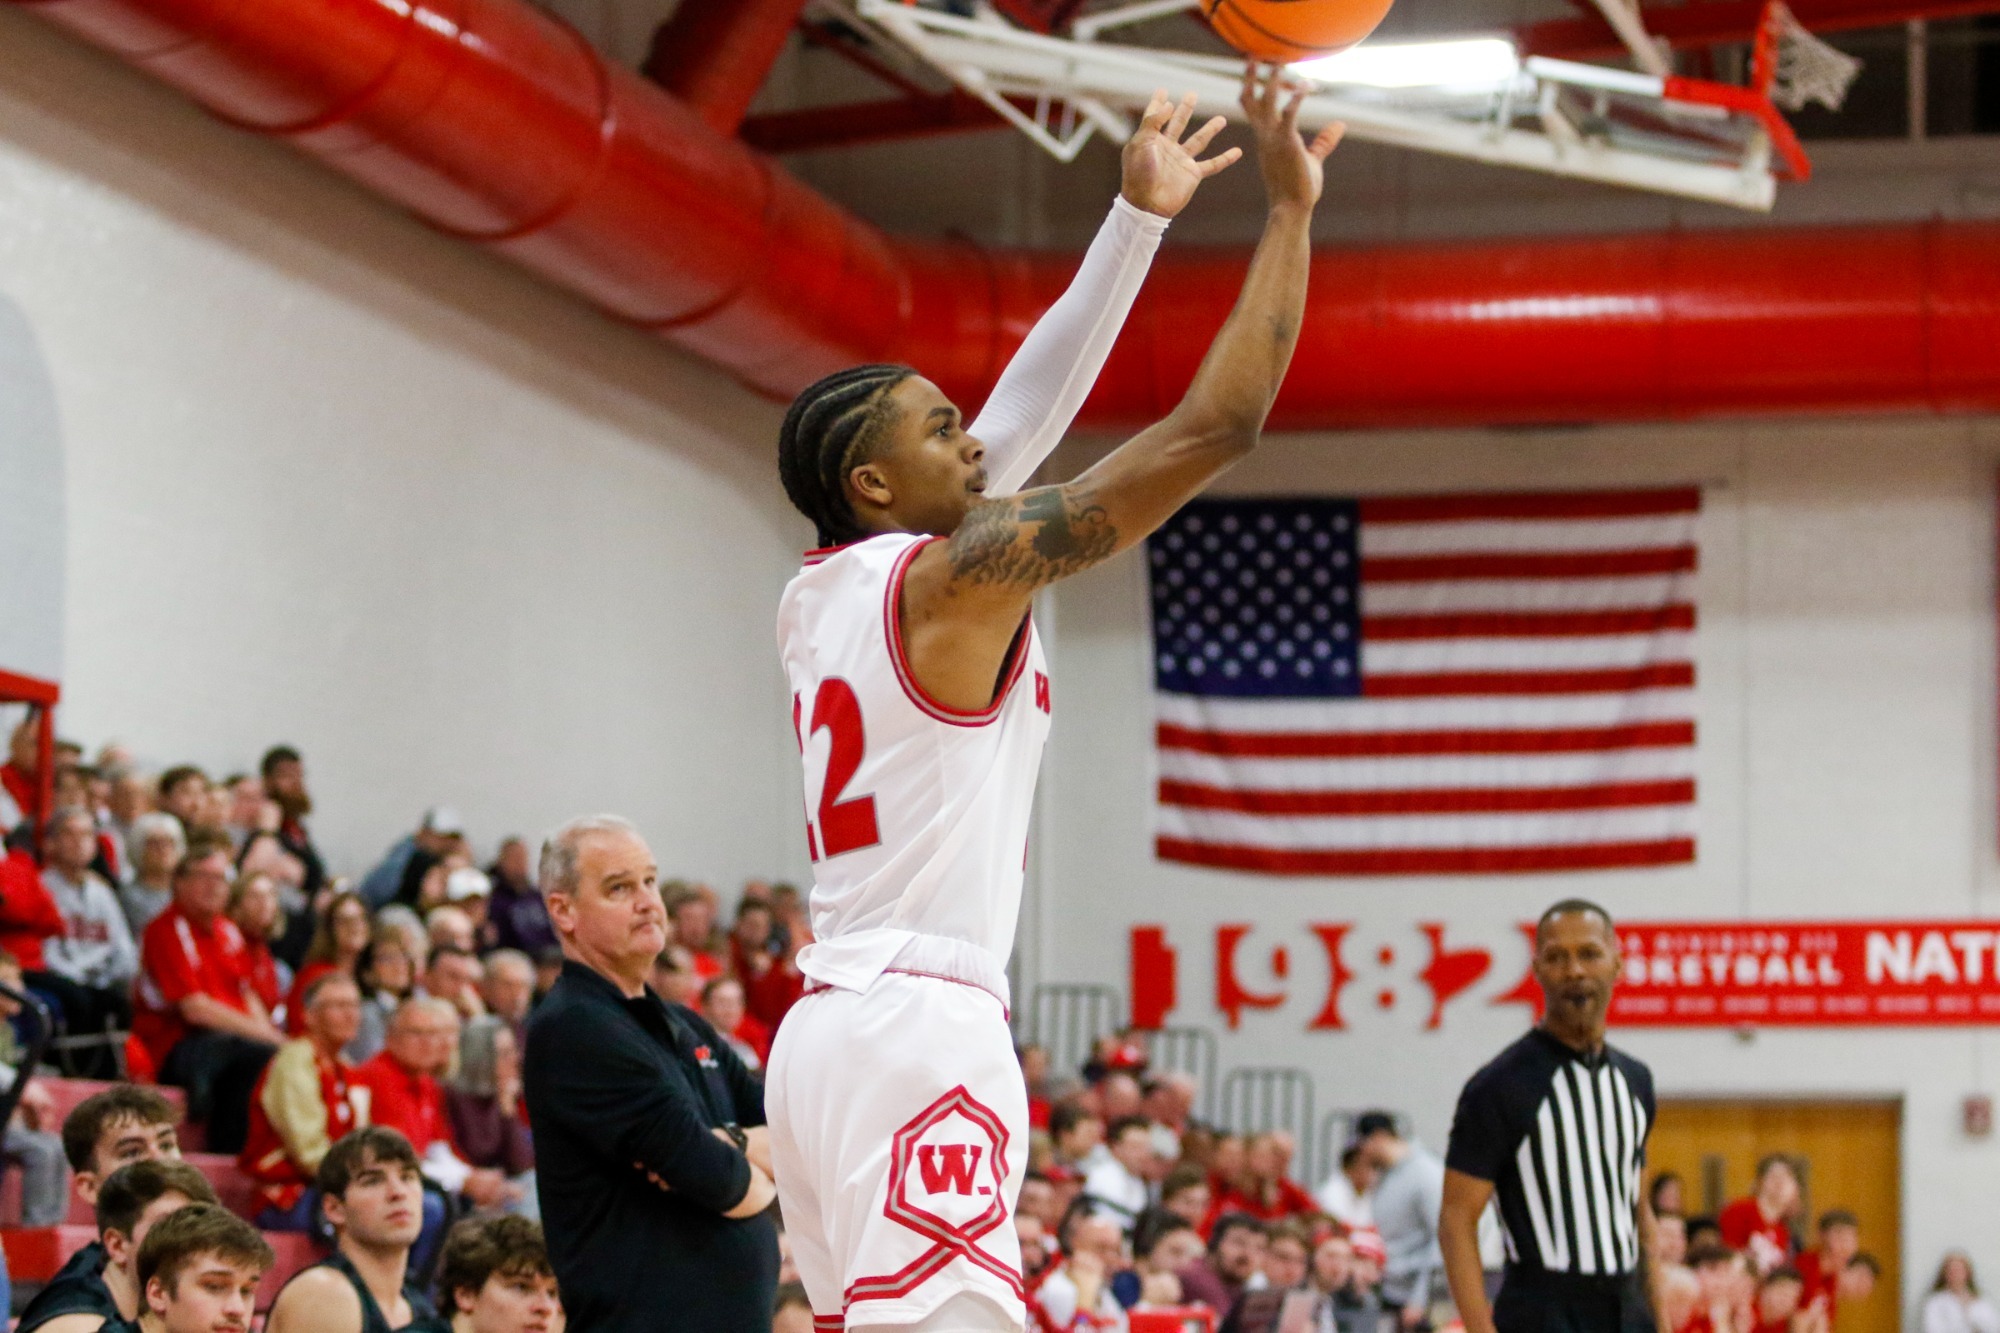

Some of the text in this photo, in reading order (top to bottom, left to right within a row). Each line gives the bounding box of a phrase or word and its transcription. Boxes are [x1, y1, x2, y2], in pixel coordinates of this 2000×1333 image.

[793, 675, 882, 864] 2
[1152, 921, 1545, 1031] 1982
[1617, 953, 1844, 987] SKETBALL
